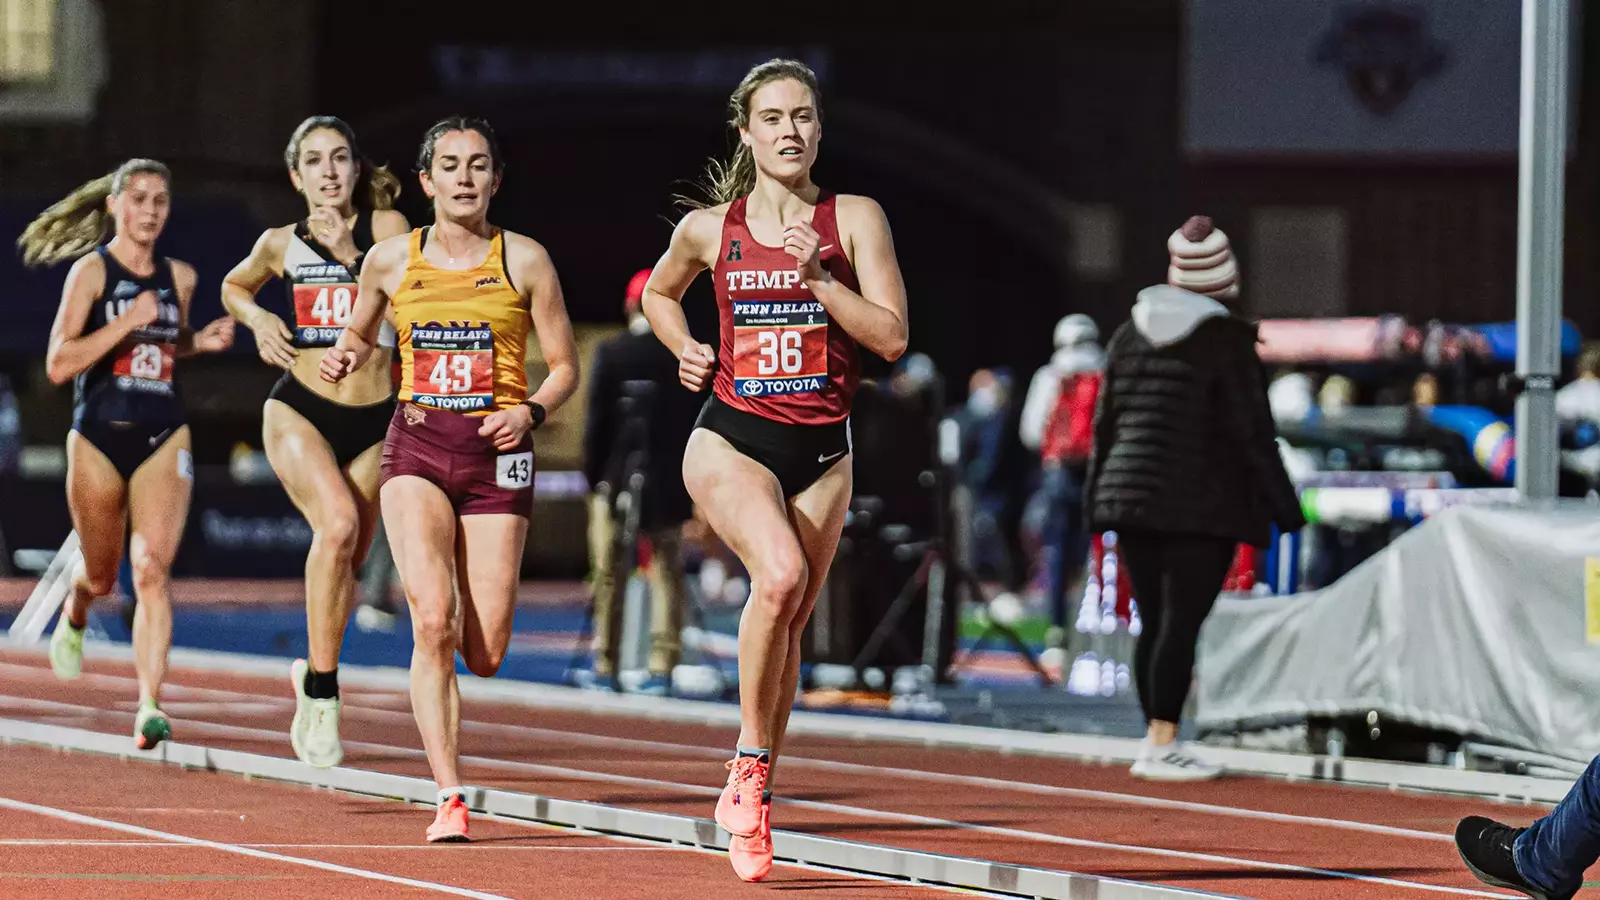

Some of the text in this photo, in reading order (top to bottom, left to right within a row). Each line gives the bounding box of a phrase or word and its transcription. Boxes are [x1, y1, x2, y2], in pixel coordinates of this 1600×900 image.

[726, 270, 808, 291] TEMP
[311, 287, 352, 325] 40
[734, 302, 824, 314] PENN RELAYS
[318, 328, 343, 339] TOY
[412, 330, 490, 340] PENN RELAYS
[130, 343, 161, 378] 23
[758, 330, 802, 375] 36
[429, 354, 472, 393] 43
[765, 378, 820, 393] TOYOTA
[436, 397, 485, 409] TOYOTA
[507, 458, 529, 483] 43
